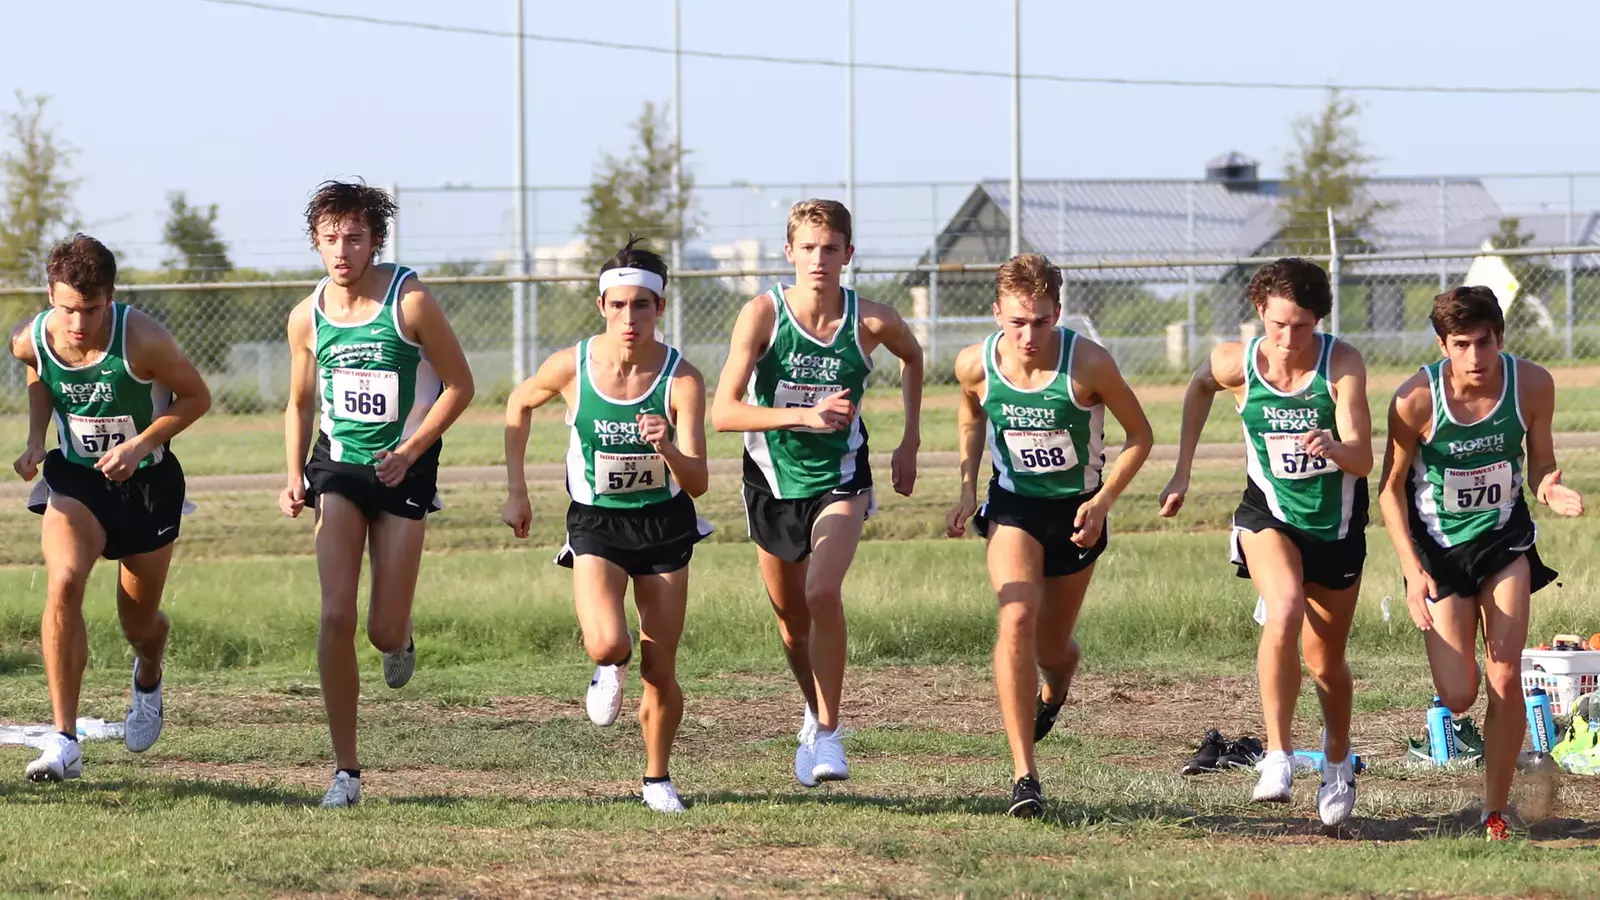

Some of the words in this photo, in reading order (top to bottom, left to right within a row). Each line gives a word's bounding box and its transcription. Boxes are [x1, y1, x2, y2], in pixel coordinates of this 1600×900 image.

[788, 352, 842, 370] NORTH
[790, 366, 838, 381] TEXAS
[59, 382, 113, 394] NORTH
[781, 382, 828, 393] NORTHWEST
[66, 391, 114, 404] TEXAS
[345, 391, 386, 415] 569
[1001, 403, 1056, 419] NORTH
[1262, 406, 1319, 419] NORTH
[70, 415, 116, 424] NORTHWEST
[1006, 416, 1055, 428] TEXAS
[1268, 418, 1318, 431] TEXAS
[594, 420, 642, 434] NORT
[1008, 430, 1053, 438] NORTHWEST
[1448, 433, 1505, 455] NORTH
[1020, 447, 1066, 468] 568
[1449, 466, 1496, 477] NORTHWEST
[608, 470, 653, 490] 574
[1457, 484, 1501, 508] 570
